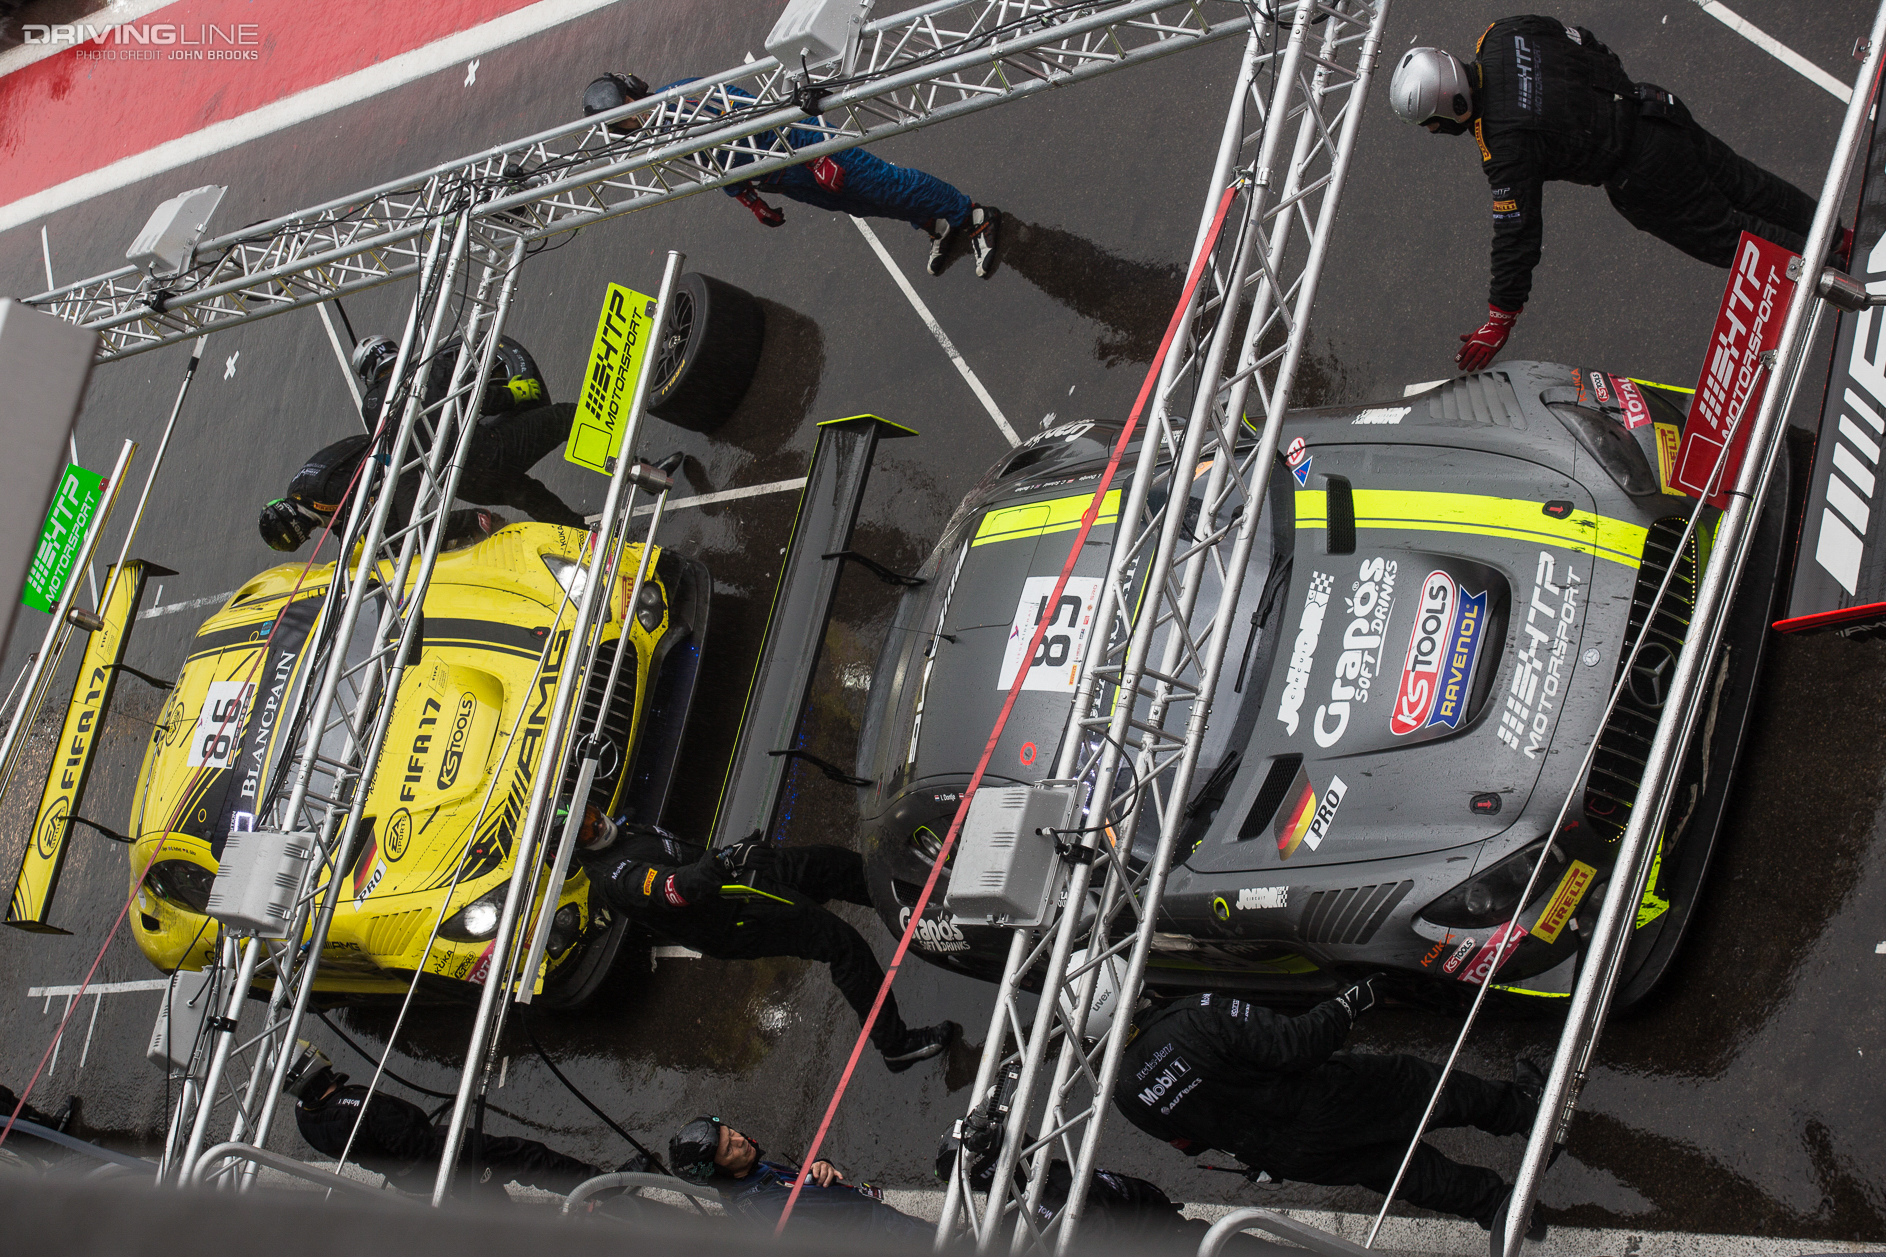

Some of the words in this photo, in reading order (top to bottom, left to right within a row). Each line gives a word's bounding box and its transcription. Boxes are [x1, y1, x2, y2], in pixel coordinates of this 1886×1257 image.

[1532, 41, 1544, 115] MOTORSPORT
[605, 306, 643, 431] MOTORSPORT
[1721, 265, 1782, 438] MOTORSPORT
[1571, 368, 1588, 402] KUKA
[1617, 376, 1645, 429] TOTAL
[45, 491, 95, 603] MOTORSPORT
[557, 525, 567, 547] KUKA
[100, 630, 109, 648] FIFA
[1028, 595, 1083, 668] 85
[1354, 651, 1376, 703] SOFT
[1370, 560, 1398, 634] DRINKS
[1440, 603, 1479, 717] RAVENOL
[431, 665, 439, 681] FIFA
[1290, 640, 1308, 700] CIRCUIT
[1524, 565, 1581, 760] MOTORSPORT
[61, 710, 95, 790] FIFA
[84, 668, 106, 704] 17
[201, 698, 242, 760] 86
[241, 651, 297, 799] BLANCPAIN
[400, 734, 432, 802] FIFA
[418, 697, 442, 730] 17
[388, 818, 402, 852] EA
[396, 814, 408, 854] SPORTS
[1310, 789, 1340, 840] PRO
[359, 868, 383, 904] PRO
[1539, 867, 1589, 935] PIRELLI
[435, 949, 455, 975] KUKA
[1420, 932, 1457, 967] KUKA
[1092, 988, 1113, 1012] uvex
[1138, 1068, 1179, 1107] Mobil
